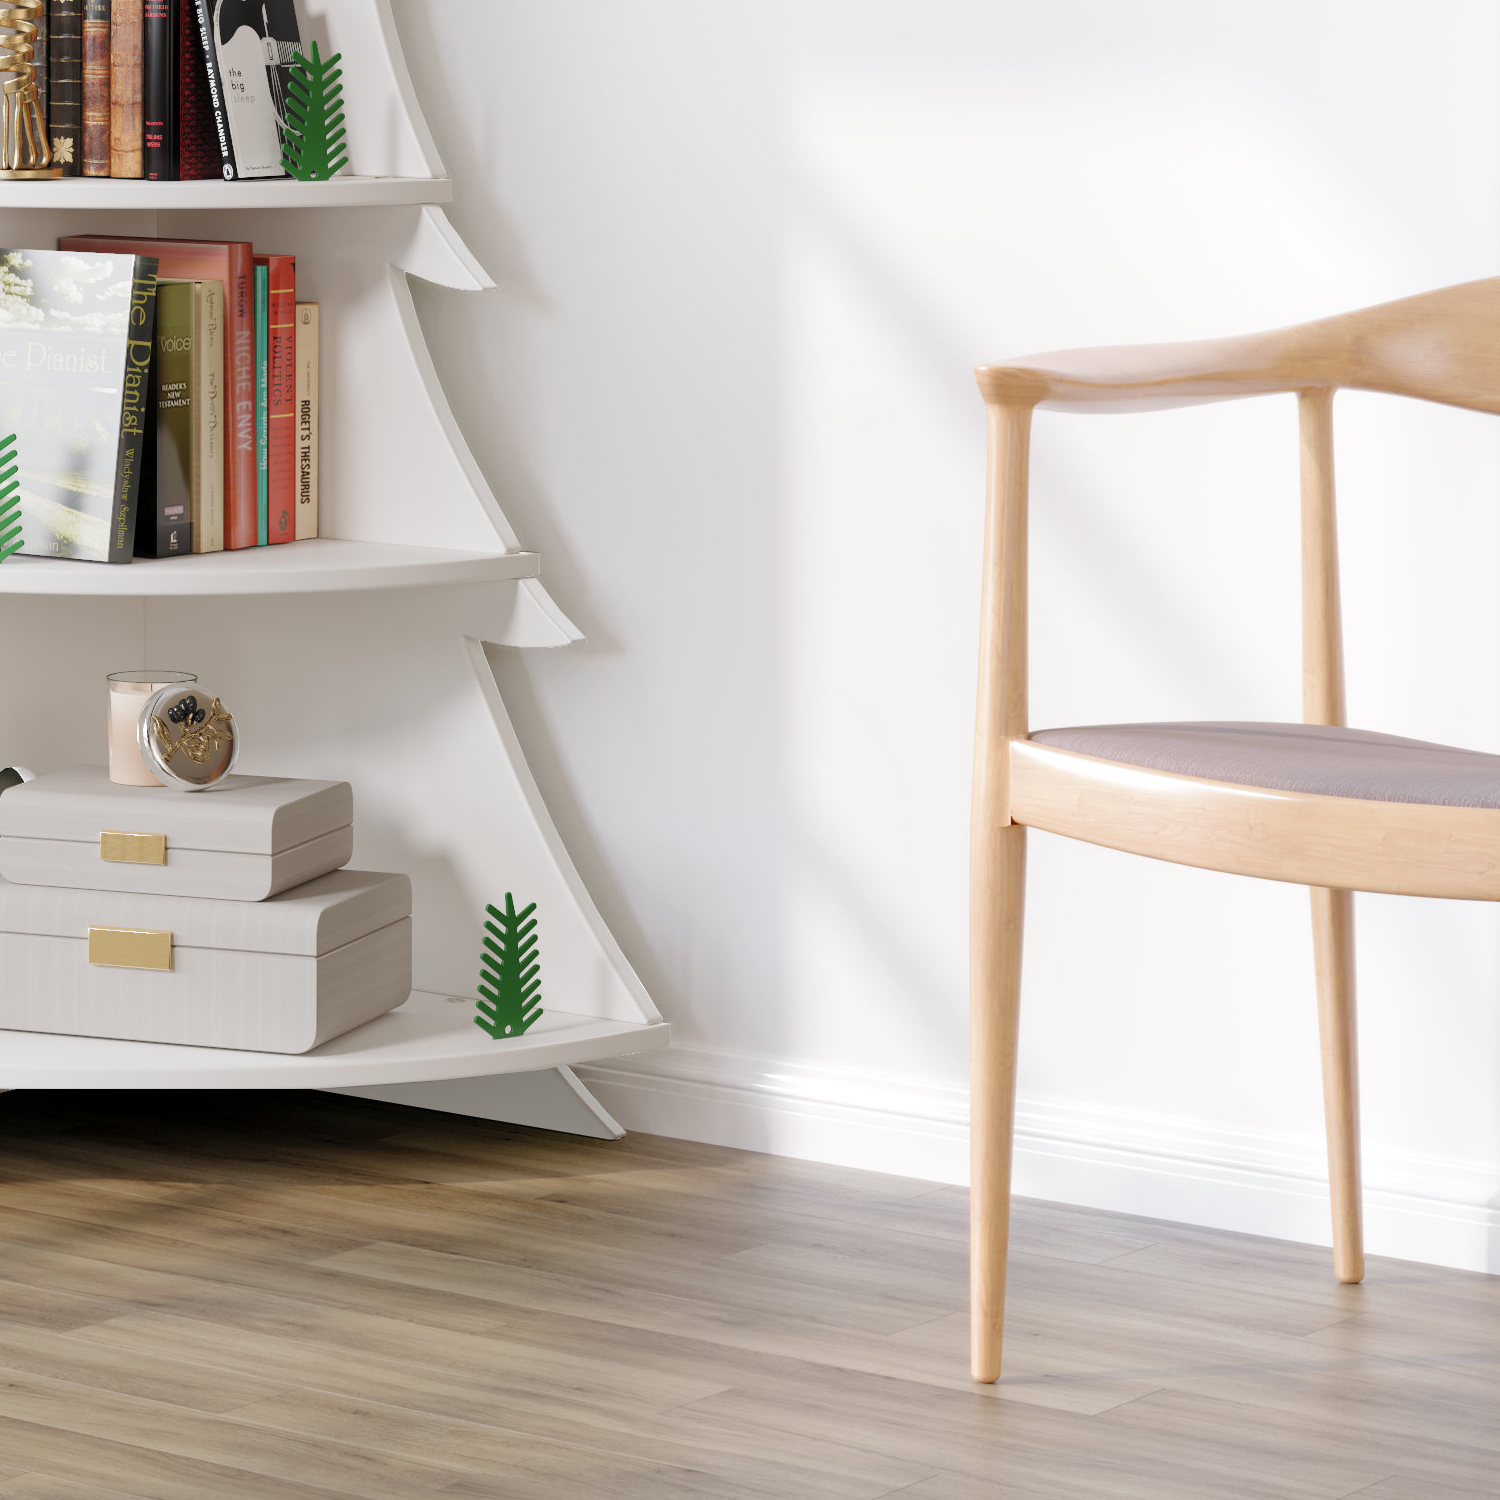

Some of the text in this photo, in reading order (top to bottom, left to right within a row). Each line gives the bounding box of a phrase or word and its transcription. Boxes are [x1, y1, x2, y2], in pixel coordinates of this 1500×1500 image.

[196, 8, 205, 24] BIG
[199, 27, 210, 51] SLEEP
[205, 61, 220, 108] RAYMOND
[228, 67, 242, 77] the
[230, 79, 245, 93] big
[214, 110, 229, 158] CHANDLER
[25, 341, 112, 374] Pianist
[120, 273, 158, 440] The Pianist
[272, 336, 282, 406] POLITICS
[285, 335, 293, 404] VIOLENT
[158, 399, 190, 408] TESTAMENT
[167, 391, 181, 399] NEW
[236, 331, 253, 451] NICHE ENVY
[300, 400, 312, 505] ROGET'S THESAURUS
[116, 503, 130, 549] Szpilman
